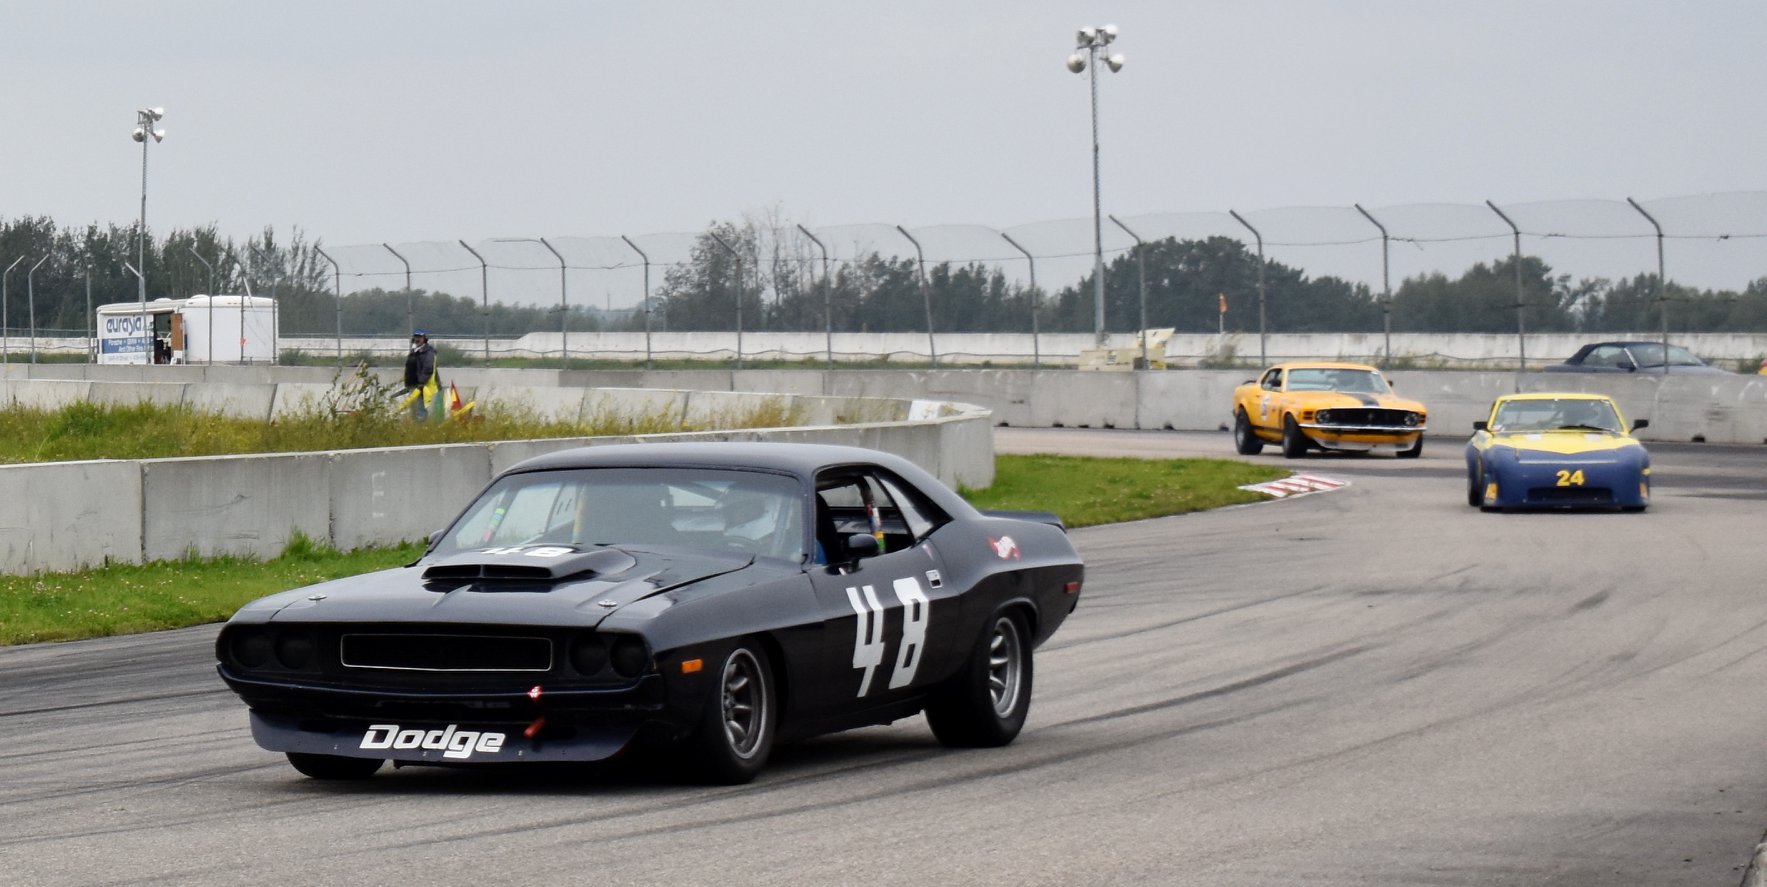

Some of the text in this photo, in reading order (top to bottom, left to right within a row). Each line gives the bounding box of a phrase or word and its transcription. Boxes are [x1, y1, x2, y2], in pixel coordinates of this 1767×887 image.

[1556, 470, 1585, 487] 24
[846, 577, 929, 698] 48
[359, 724, 505, 759] Dodge
